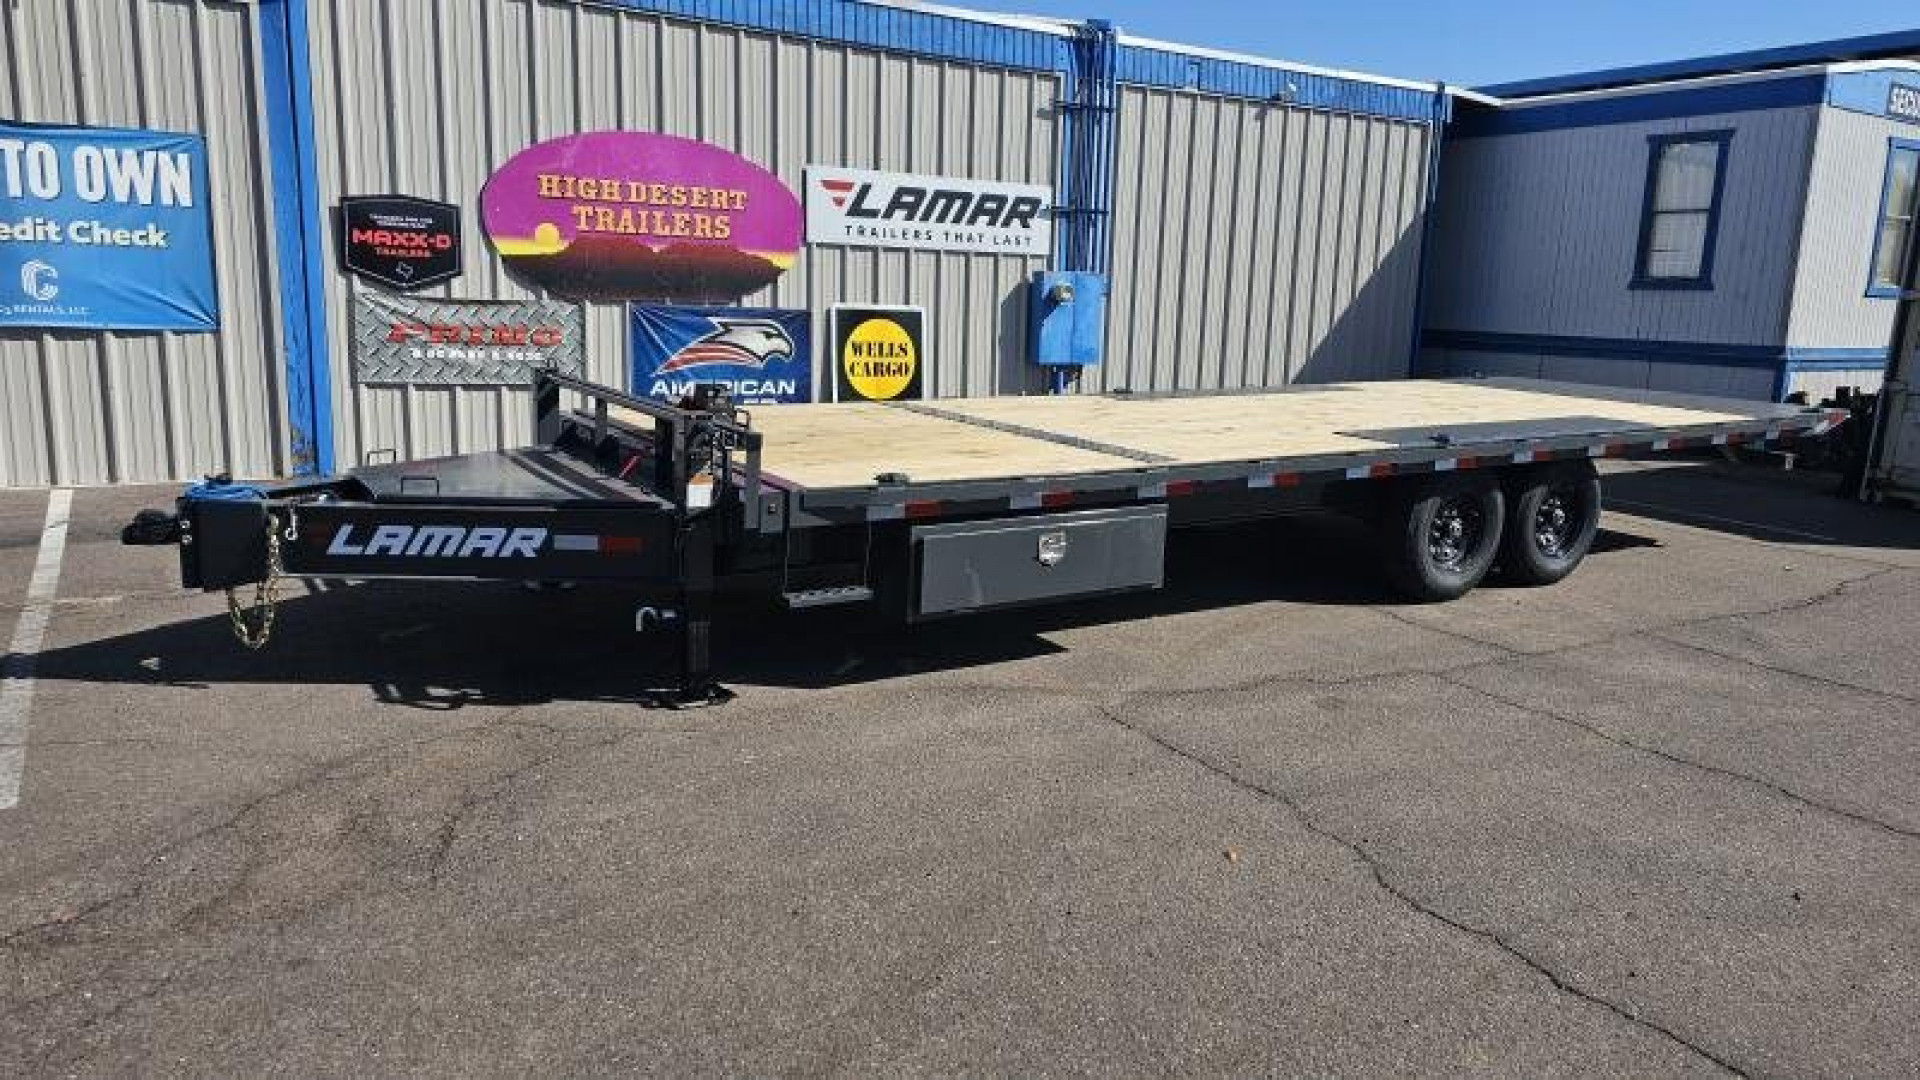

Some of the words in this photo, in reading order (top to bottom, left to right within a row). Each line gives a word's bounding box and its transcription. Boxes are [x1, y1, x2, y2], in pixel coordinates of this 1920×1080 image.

[0, 139, 61, 200] TO
[73, 146, 193, 207] OWN
[537, 174, 623, 201] HIGH
[628, 181, 748, 210] DESERT
[845, 182, 1042, 228] LAMAR
[69, 220, 169, 248] Check
[572, 205, 731, 239] TRAILERS
[844, 225, 932, 241] TRAILERS
[943, 230, 984, 243] THAT
[993, 235, 1032, 246] LAST
[352, 229, 451, 248] MAXX-D
[851, 342, 908, 358] WELLS
[849, 361, 910, 378] CARGO
[326, 524, 548, 558] LAMAR
